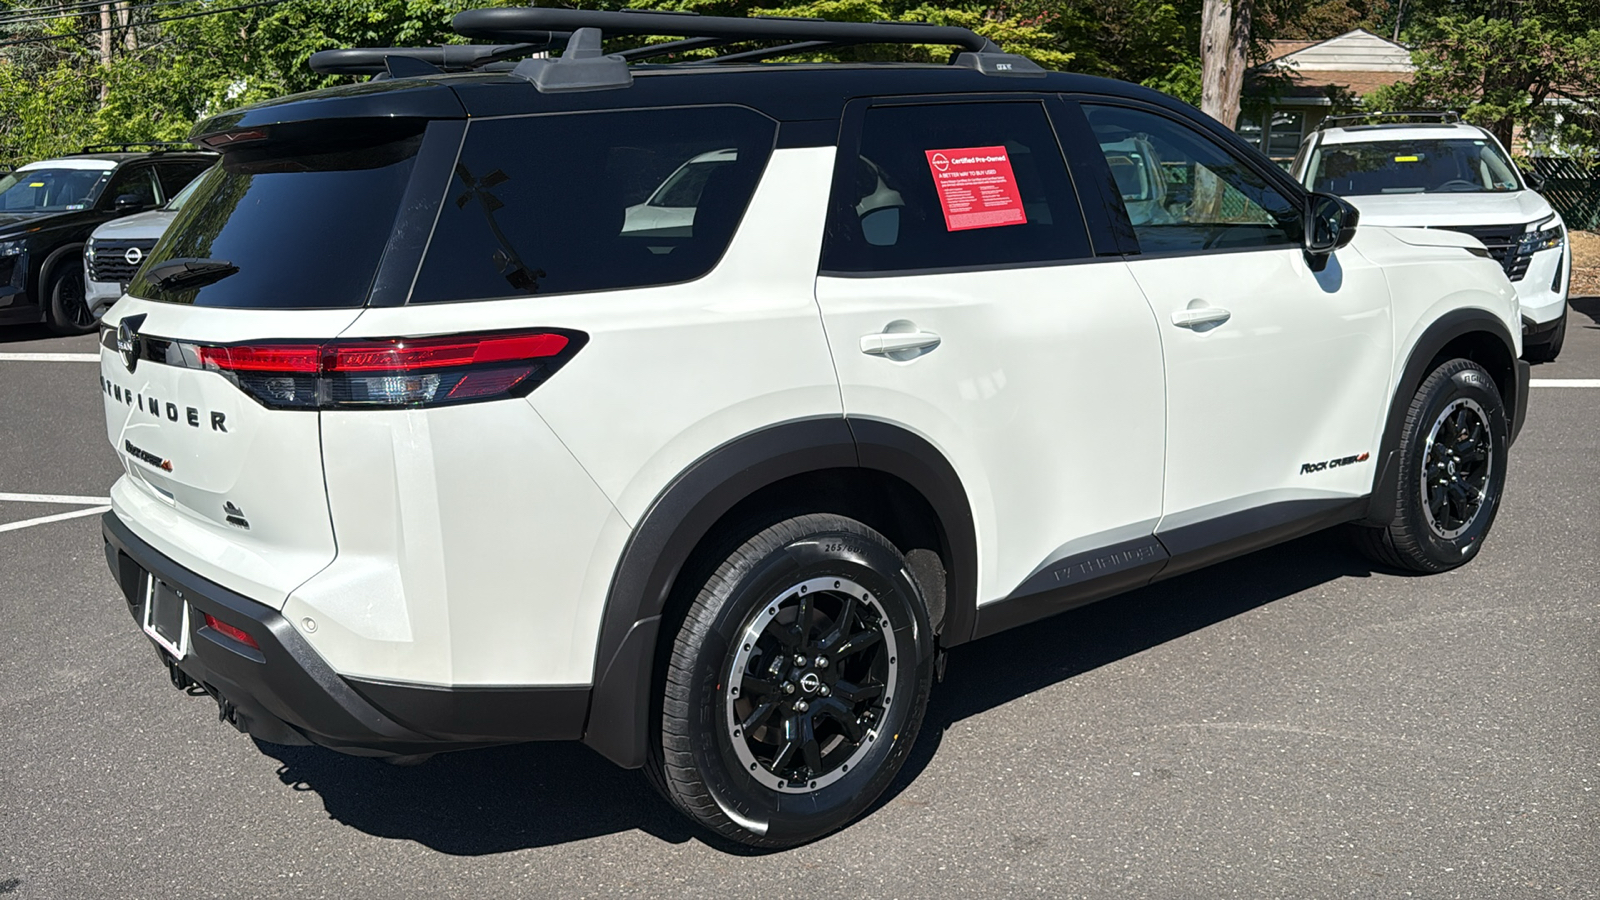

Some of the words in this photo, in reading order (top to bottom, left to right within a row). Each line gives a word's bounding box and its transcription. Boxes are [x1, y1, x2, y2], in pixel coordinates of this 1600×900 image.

[951, 157, 975, 165] Certified
[976, 155, 1006, 163] Pre-Owned
[100, 375, 228, 433] ATHFINDER
[1299, 461, 1328, 475] ROCK
[1329, 454, 1359, 469] CREEK
